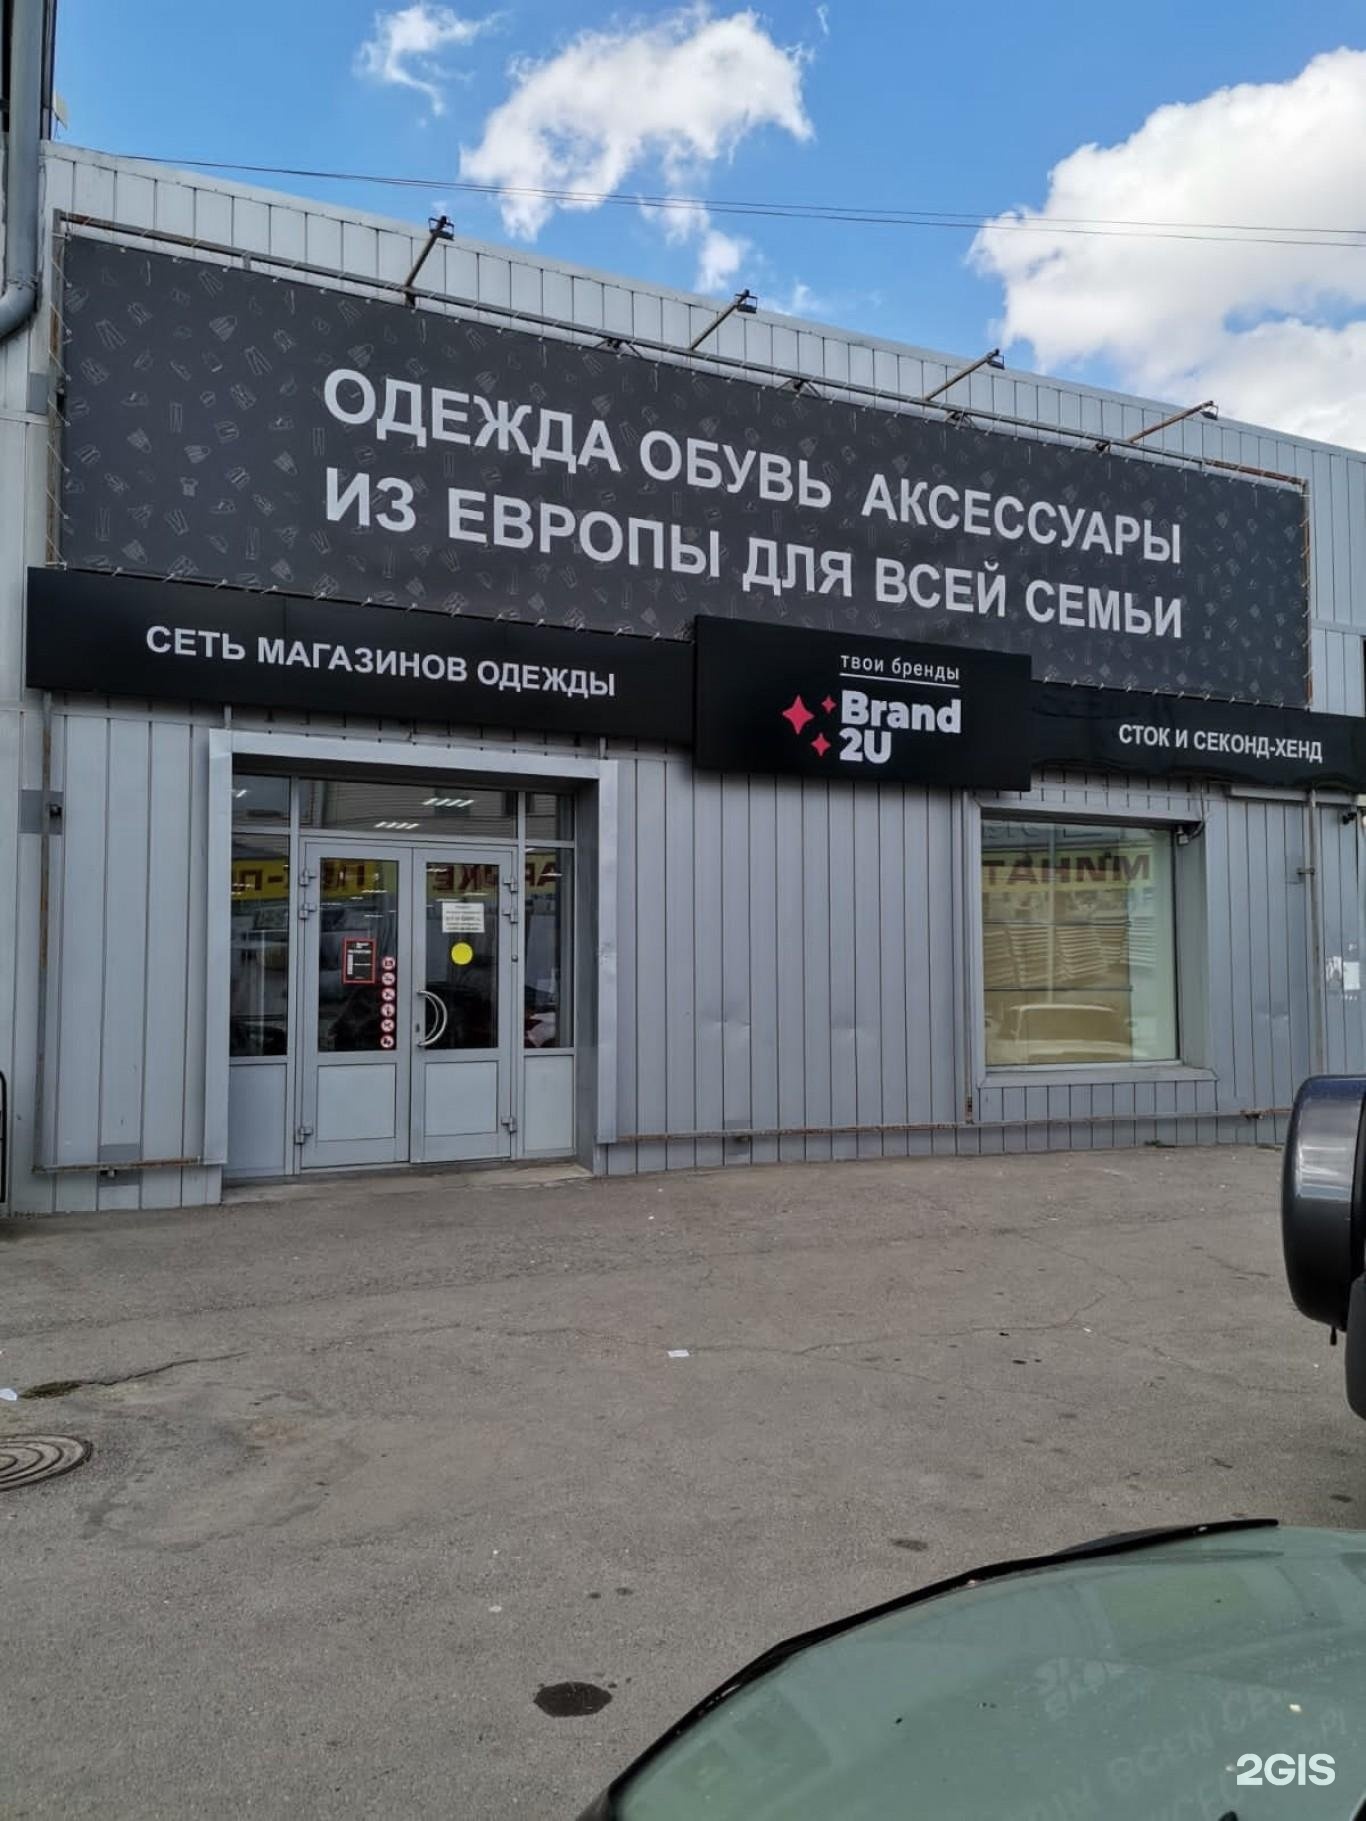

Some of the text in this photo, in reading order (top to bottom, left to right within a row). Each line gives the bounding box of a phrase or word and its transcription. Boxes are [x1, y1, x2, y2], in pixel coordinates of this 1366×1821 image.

[324, 368, 1181, 565] ОДЕЖДА ОБУВЬ АКСЕССУАРЫ
[326, 467, 1182, 638] ИЗ ЕВРОПЫ ДЛЯ ВСЕЙ СЕМЬИ
[146, 625, 615, 699] СЕТЬ МАГАЗИНОВ ОДЕЖДЫ
[840, 655, 959, 682] твои бренды
[841, 689, 961, 734] Brand
[840, 727, 892, 764] 2U
[1118, 723, 1323, 764] СТОК И СЕКОНД-ХЕНД
